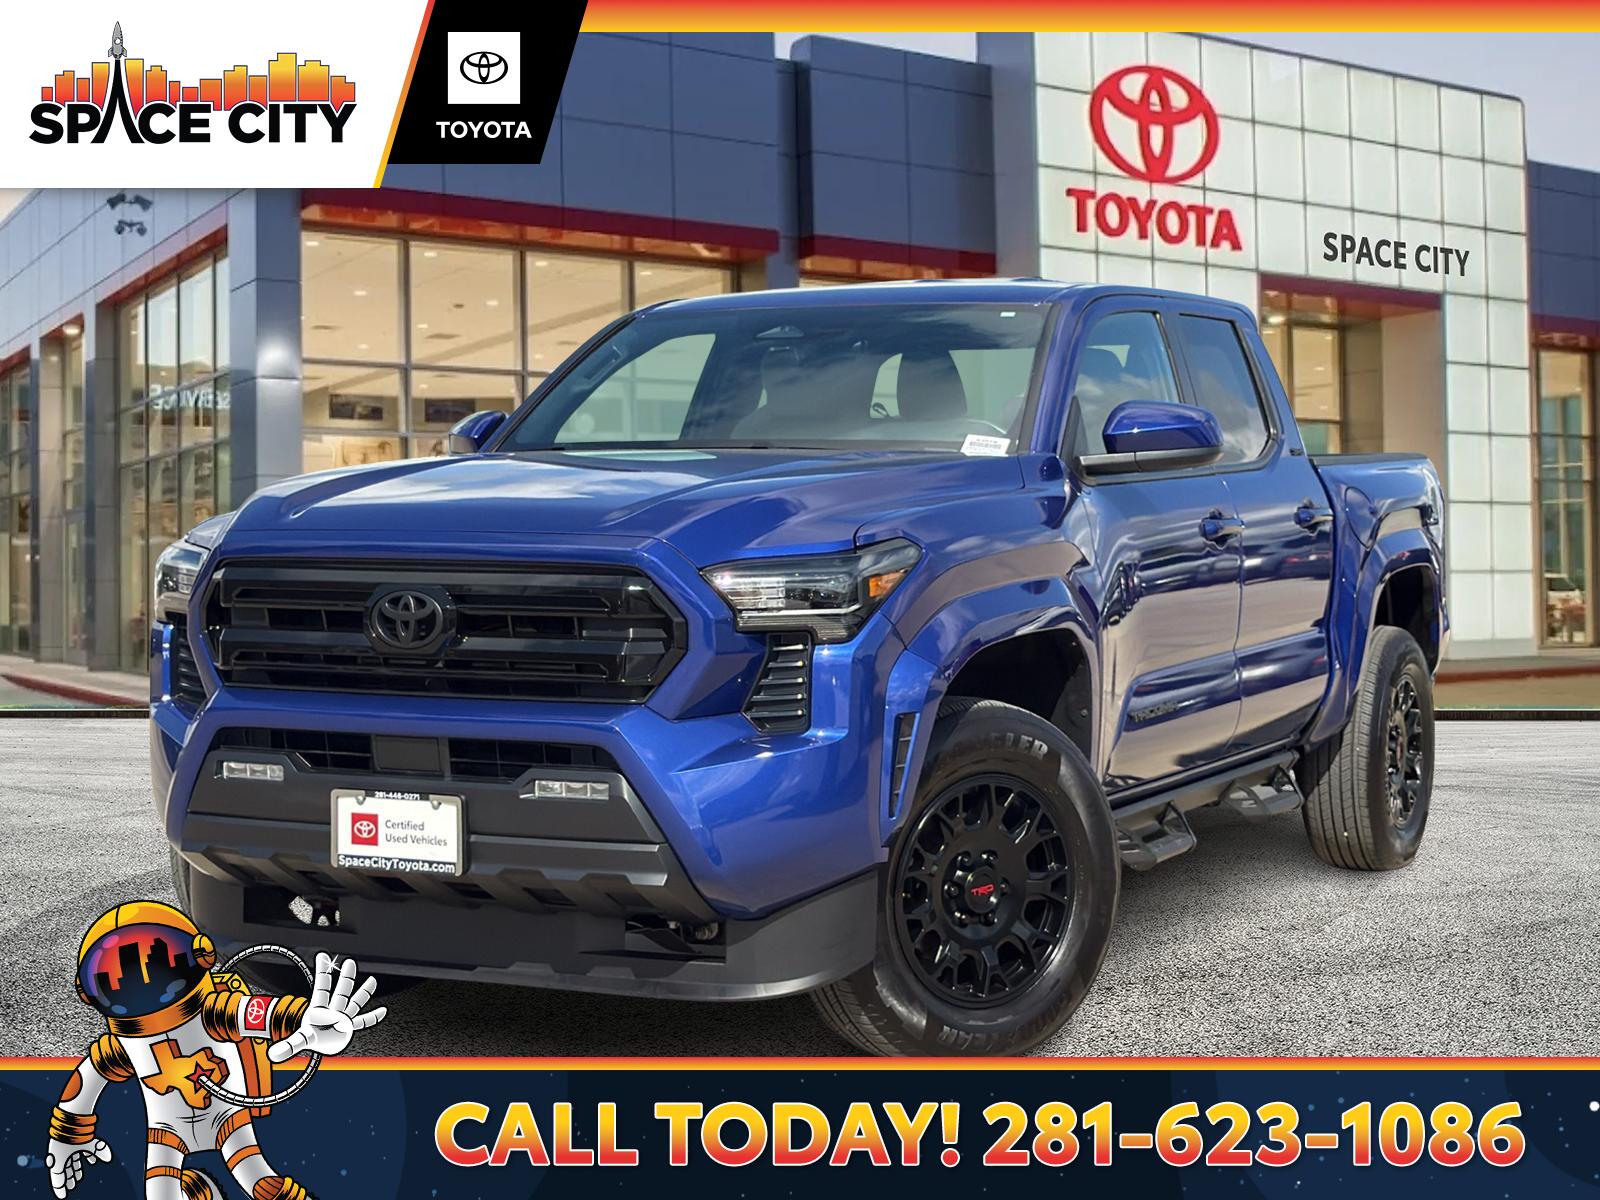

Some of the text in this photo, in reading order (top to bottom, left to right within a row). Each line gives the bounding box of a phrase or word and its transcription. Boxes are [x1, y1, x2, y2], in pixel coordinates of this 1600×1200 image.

[1066, 187, 1242, 251] TOYOTA
[1323, 232, 1470, 277] SPACE CITY
[385, 819, 425, 831] Certified
[385, 834, 448, 847] Used Vehicles
[338, 854, 456, 873] SpaceCityToyota.com
[971, 883, 995, 896] TRD
